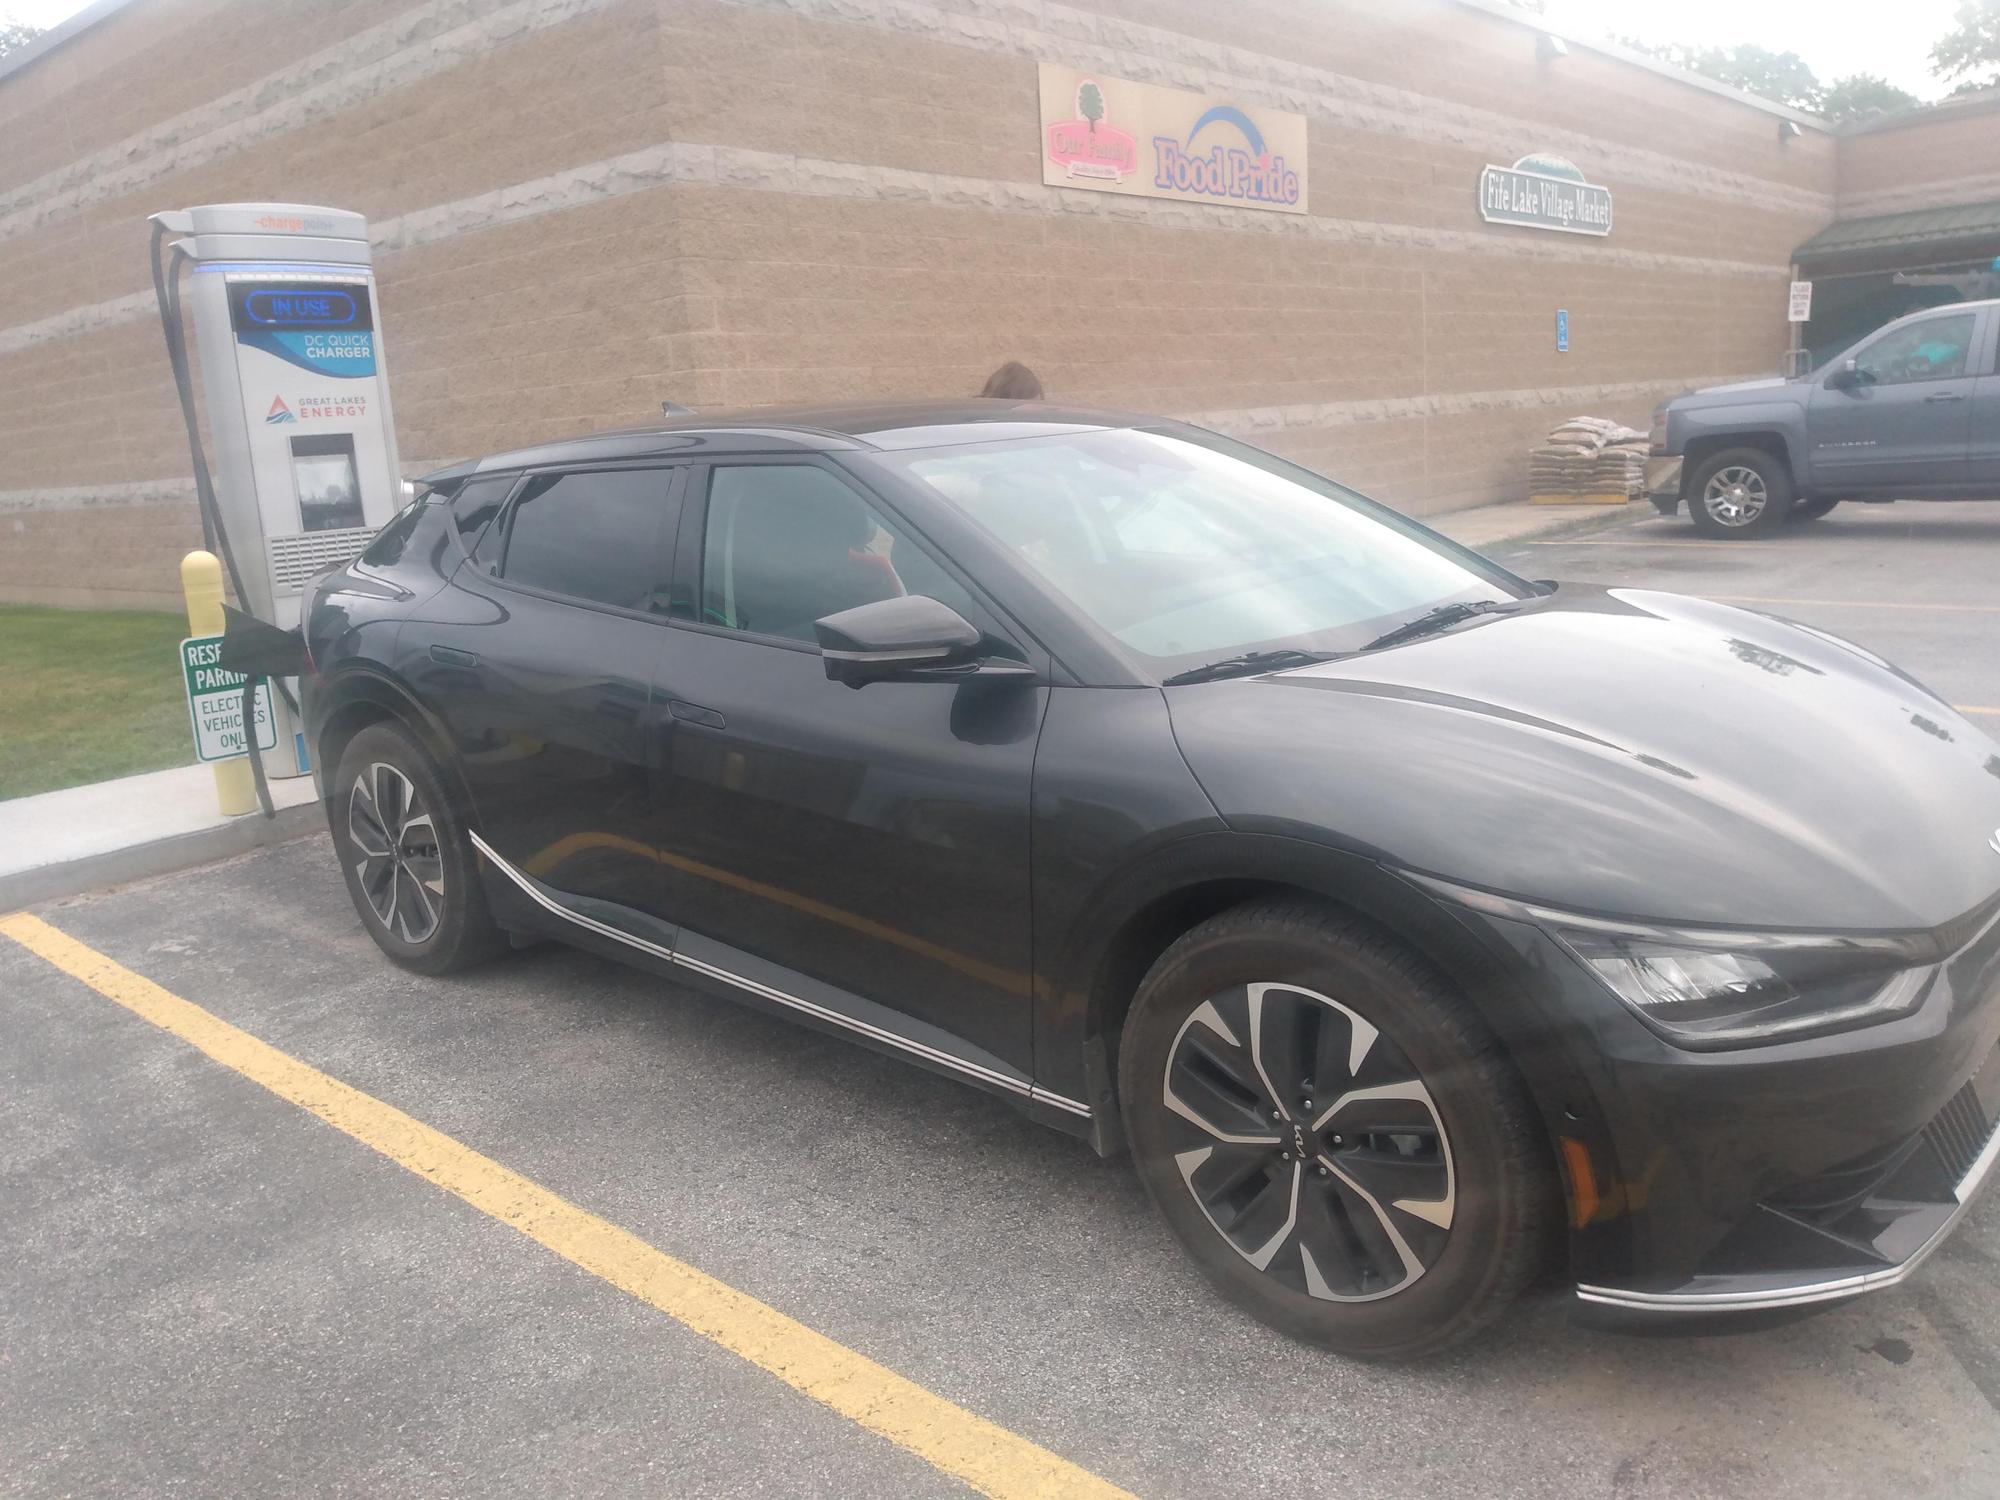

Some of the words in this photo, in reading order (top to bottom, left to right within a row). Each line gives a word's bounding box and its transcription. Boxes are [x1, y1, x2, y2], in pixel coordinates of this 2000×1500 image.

[1153, 136, 1227, 196] Food
[1228, 149, 1299, 205] Pride
[1487, 173, 1509, 211] Fife
[1511, 176, 1538, 216] Lake
[1540, 182, 1574, 226] Village
[1575, 189, 1609, 225] Market
[271, 298, 292, 316] IN
[295, 298, 332, 317] USE
[304, 335, 324, 346] DC
[328, 334, 369, 346] QUICK
[306, 347, 370, 358] CHARGER
[299, 397, 331, 406] GREAT
[334, 396, 366, 406] LAKES
[300, 406, 366, 418] ENERGY
[202, 693, 261, 714] ELECTC
[220, 732, 248, 748] ONL
